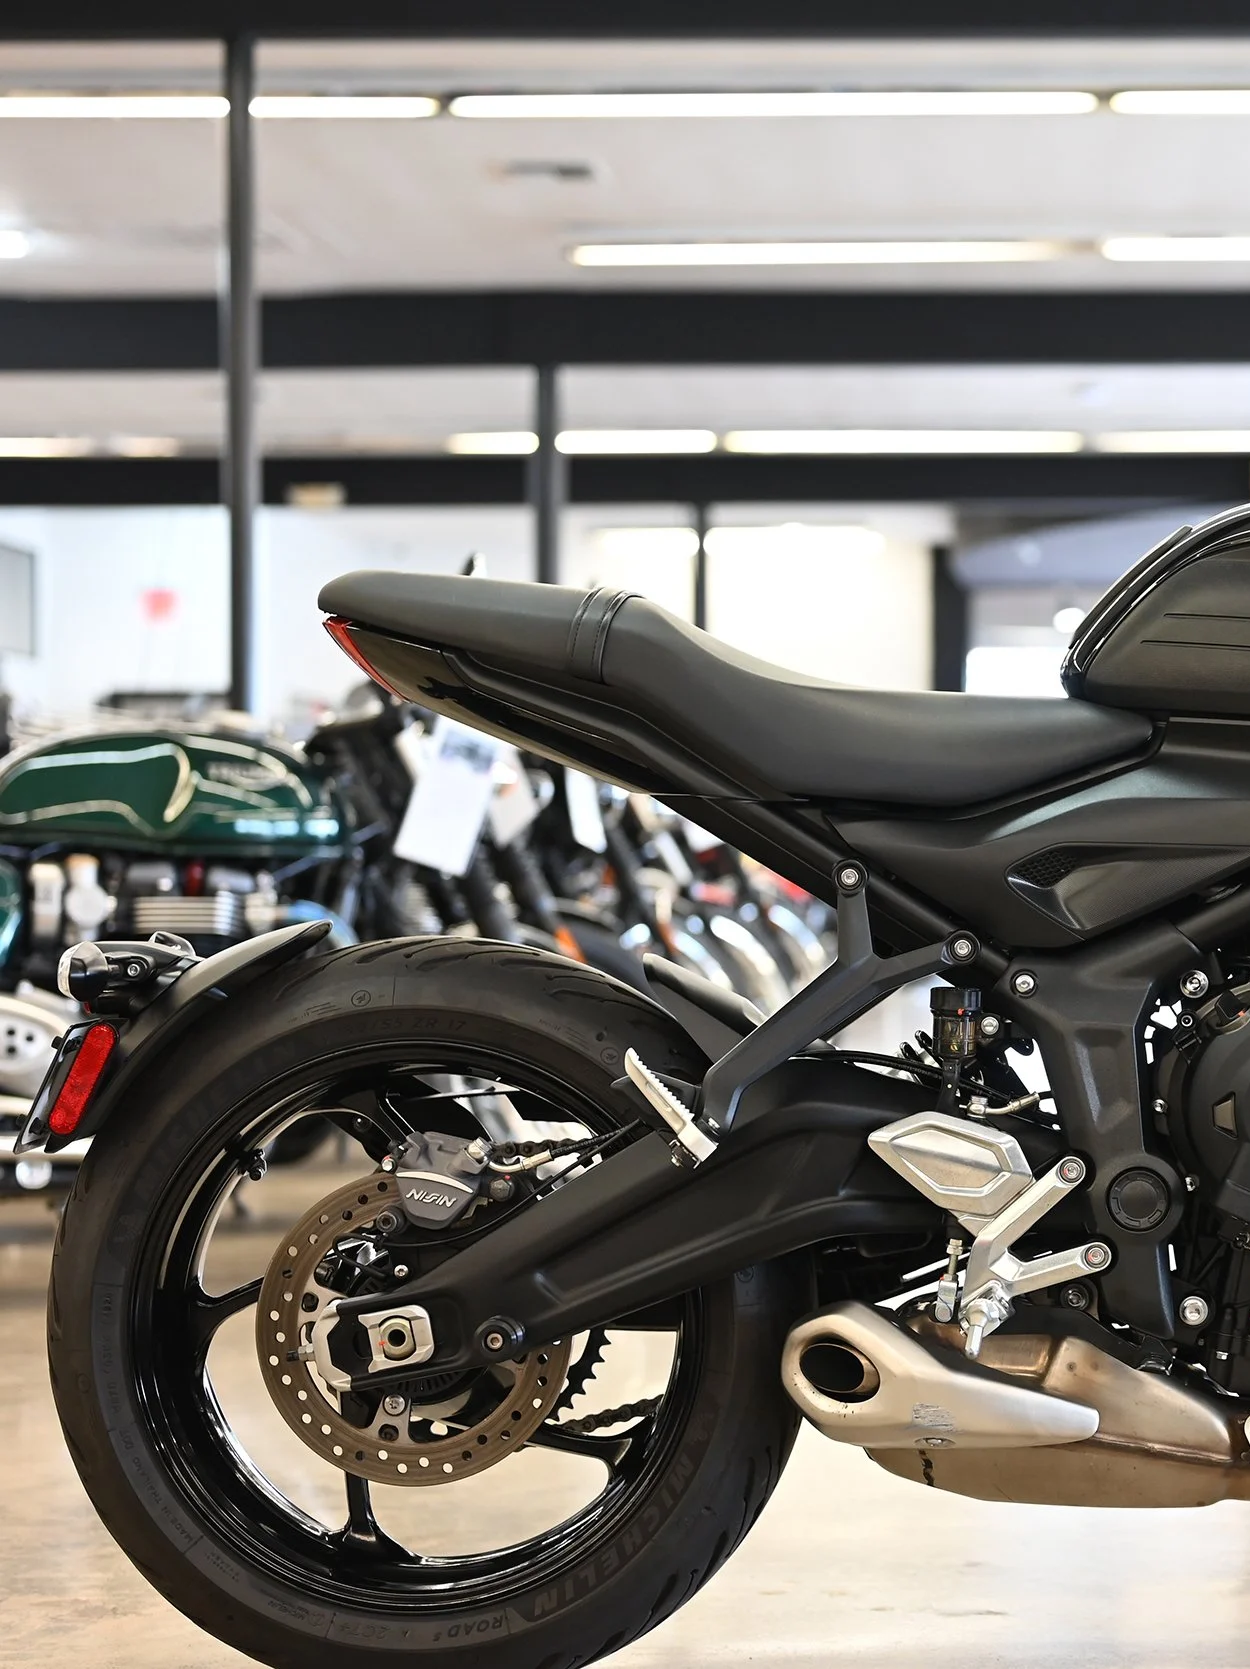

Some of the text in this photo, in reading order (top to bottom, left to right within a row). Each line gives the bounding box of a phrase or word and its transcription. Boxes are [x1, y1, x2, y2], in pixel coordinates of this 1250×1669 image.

[410, 1016, 438, 1030] ZR
[448, 1019, 468, 1032] 17
[526, 1449, 700, 1619] MICHELIN
[446, 1612, 507, 1638] ROAD
